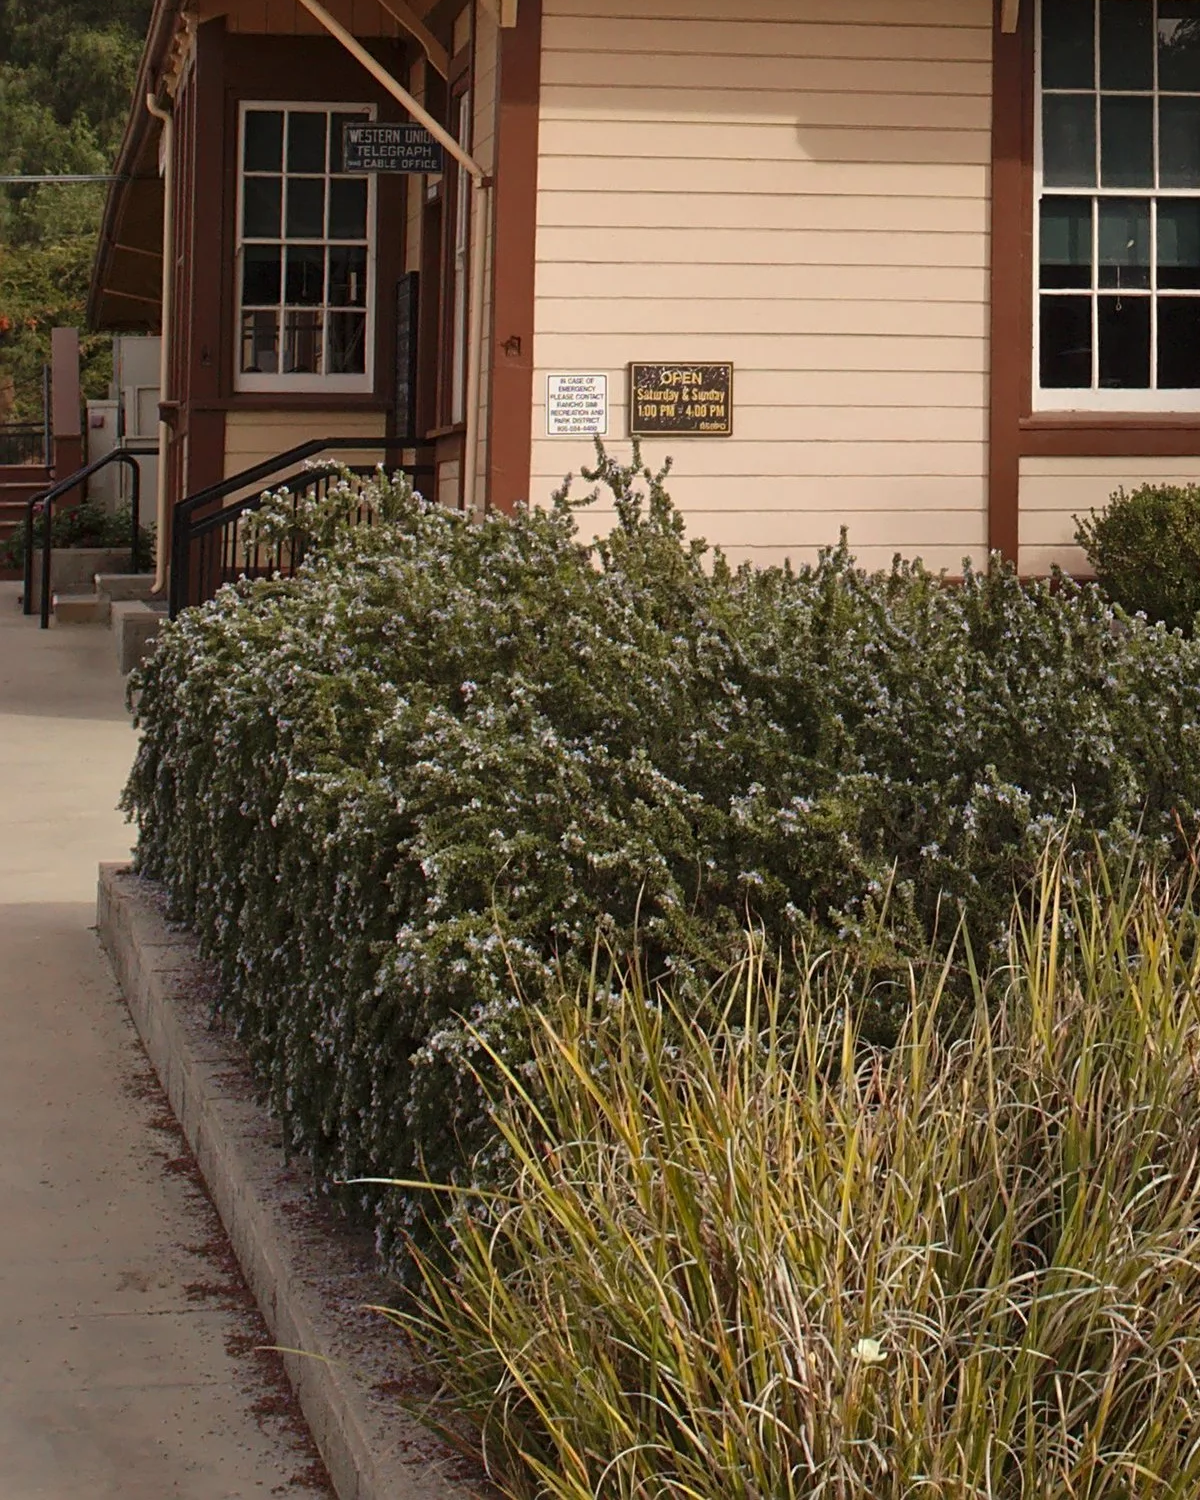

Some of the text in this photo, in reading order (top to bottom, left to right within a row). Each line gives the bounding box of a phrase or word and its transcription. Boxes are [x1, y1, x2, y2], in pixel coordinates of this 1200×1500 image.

[349, 129, 400, 143] WESTERN
[357, 145, 432, 157] TELEGRAPH
[363, 159, 396, 168] CABLE
[402, 159, 437, 169] OFFICE
[660, 370, 702, 385] OPEN
[637, 387, 725, 403] Saturday & Sunday
[660, 405, 675, 417] PM
[710, 405, 724, 417] PM
